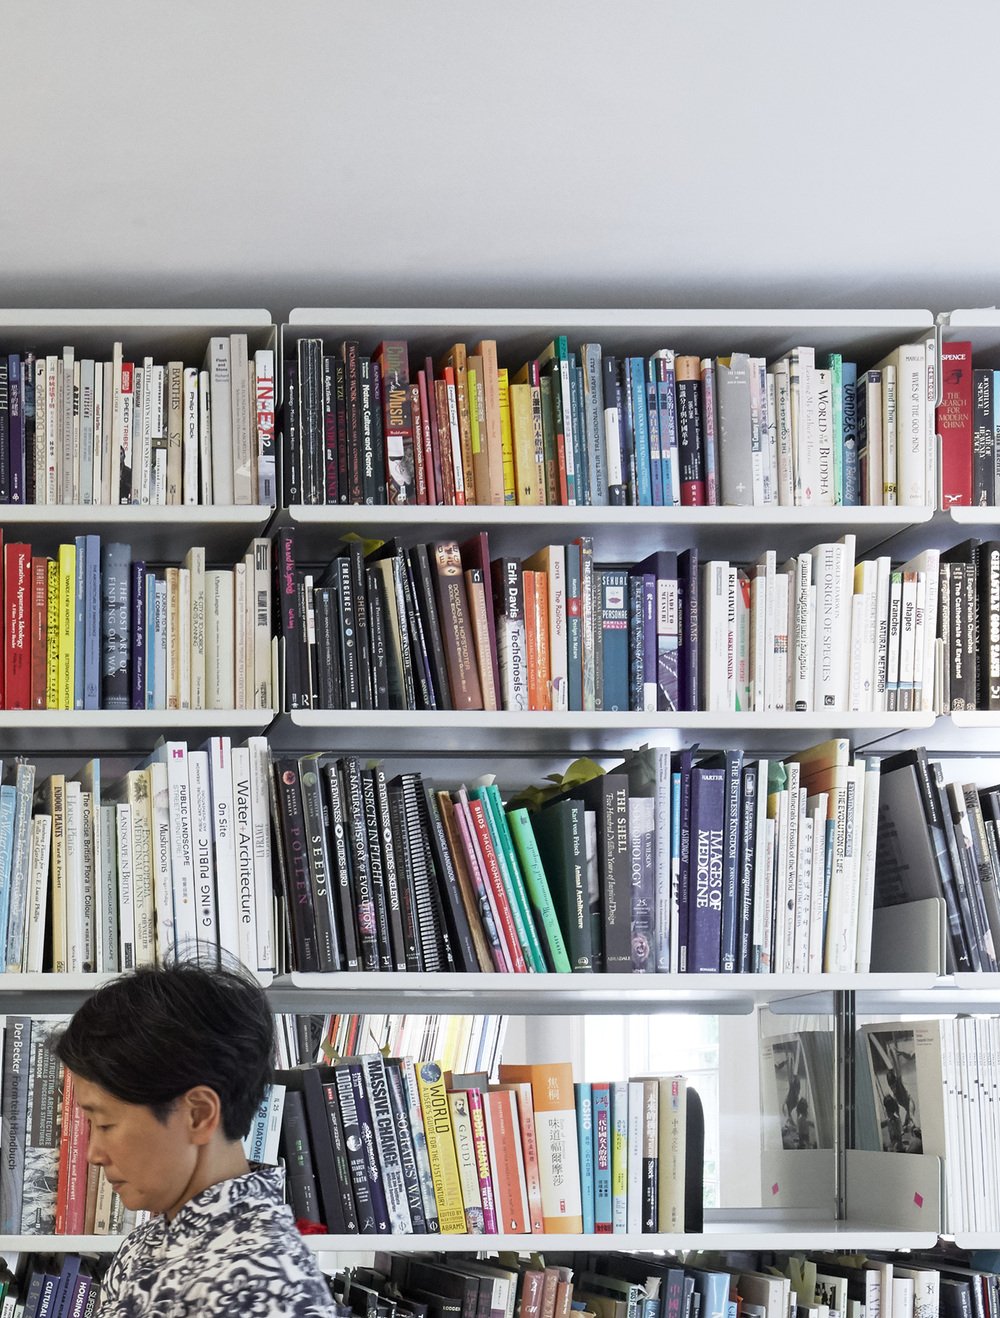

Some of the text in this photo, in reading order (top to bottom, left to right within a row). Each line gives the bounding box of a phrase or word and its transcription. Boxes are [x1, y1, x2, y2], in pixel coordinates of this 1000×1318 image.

[363, 385, 371, 409] Nature,
[507, 563, 519, 618] Erik Davis
[890, 599, 900, 636] branches
[903, 602, 913, 631] shapes
[108, 577, 116, 677] FINDING OUR WAY
[119, 581, 128, 673] THE LOST ART OF
[511, 629, 522, 691] TechGnosis
[159, 823, 169, 872] Mushrooms
[218, 803, 227, 837] On Site
[364, 778, 382, 886] INSECTS IN FLIGHT
[617, 789, 626, 853] THE SHELL
[291, 828, 308, 904] POLLEN
[312, 836, 326, 896] SEEDS
[697, 830, 709, 907] MEDICINE
[710, 830, 722, 909] IMAGES OF
[576, 889, 585, 928] Architecture
[368, 1061, 397, 1168] MASSIVE CHANGE
